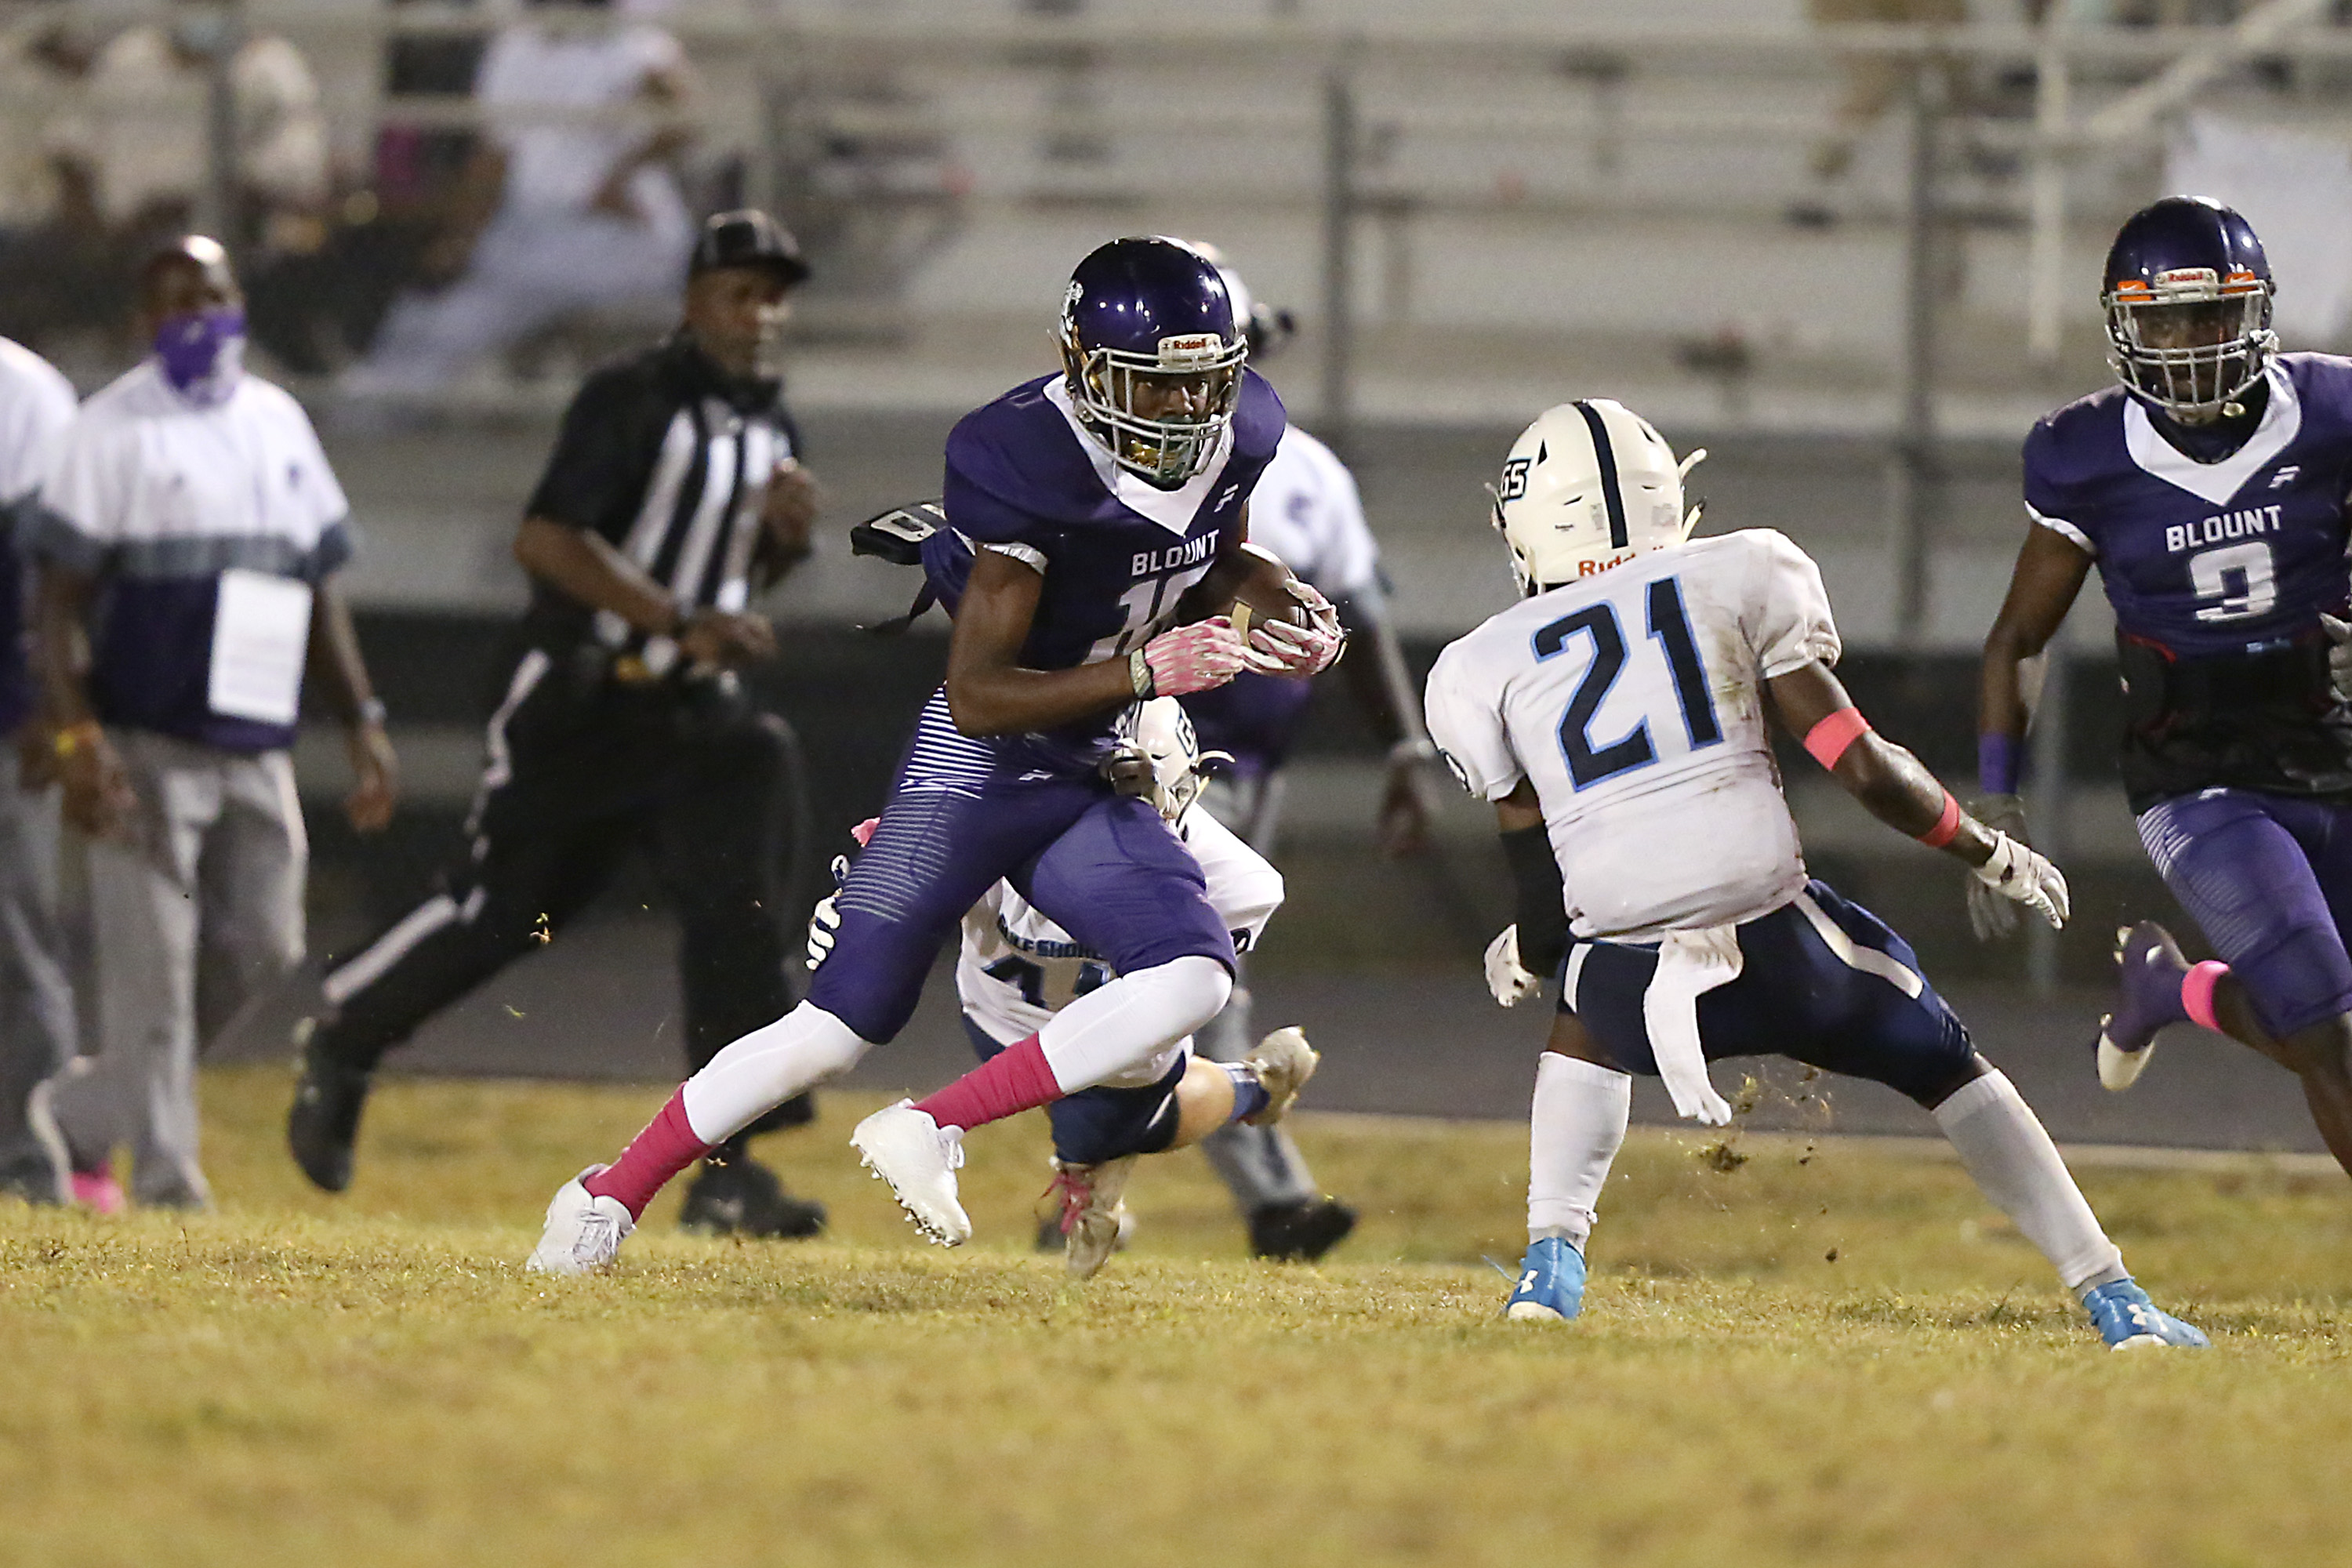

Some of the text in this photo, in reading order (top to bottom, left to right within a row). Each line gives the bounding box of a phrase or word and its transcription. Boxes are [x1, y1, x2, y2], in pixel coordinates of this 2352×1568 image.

[1131, 528, 1220, 576] BLOUNT
[2166, 505, 2282, 553] BLOUNT
[1530, 573, 1724, 793] 21
